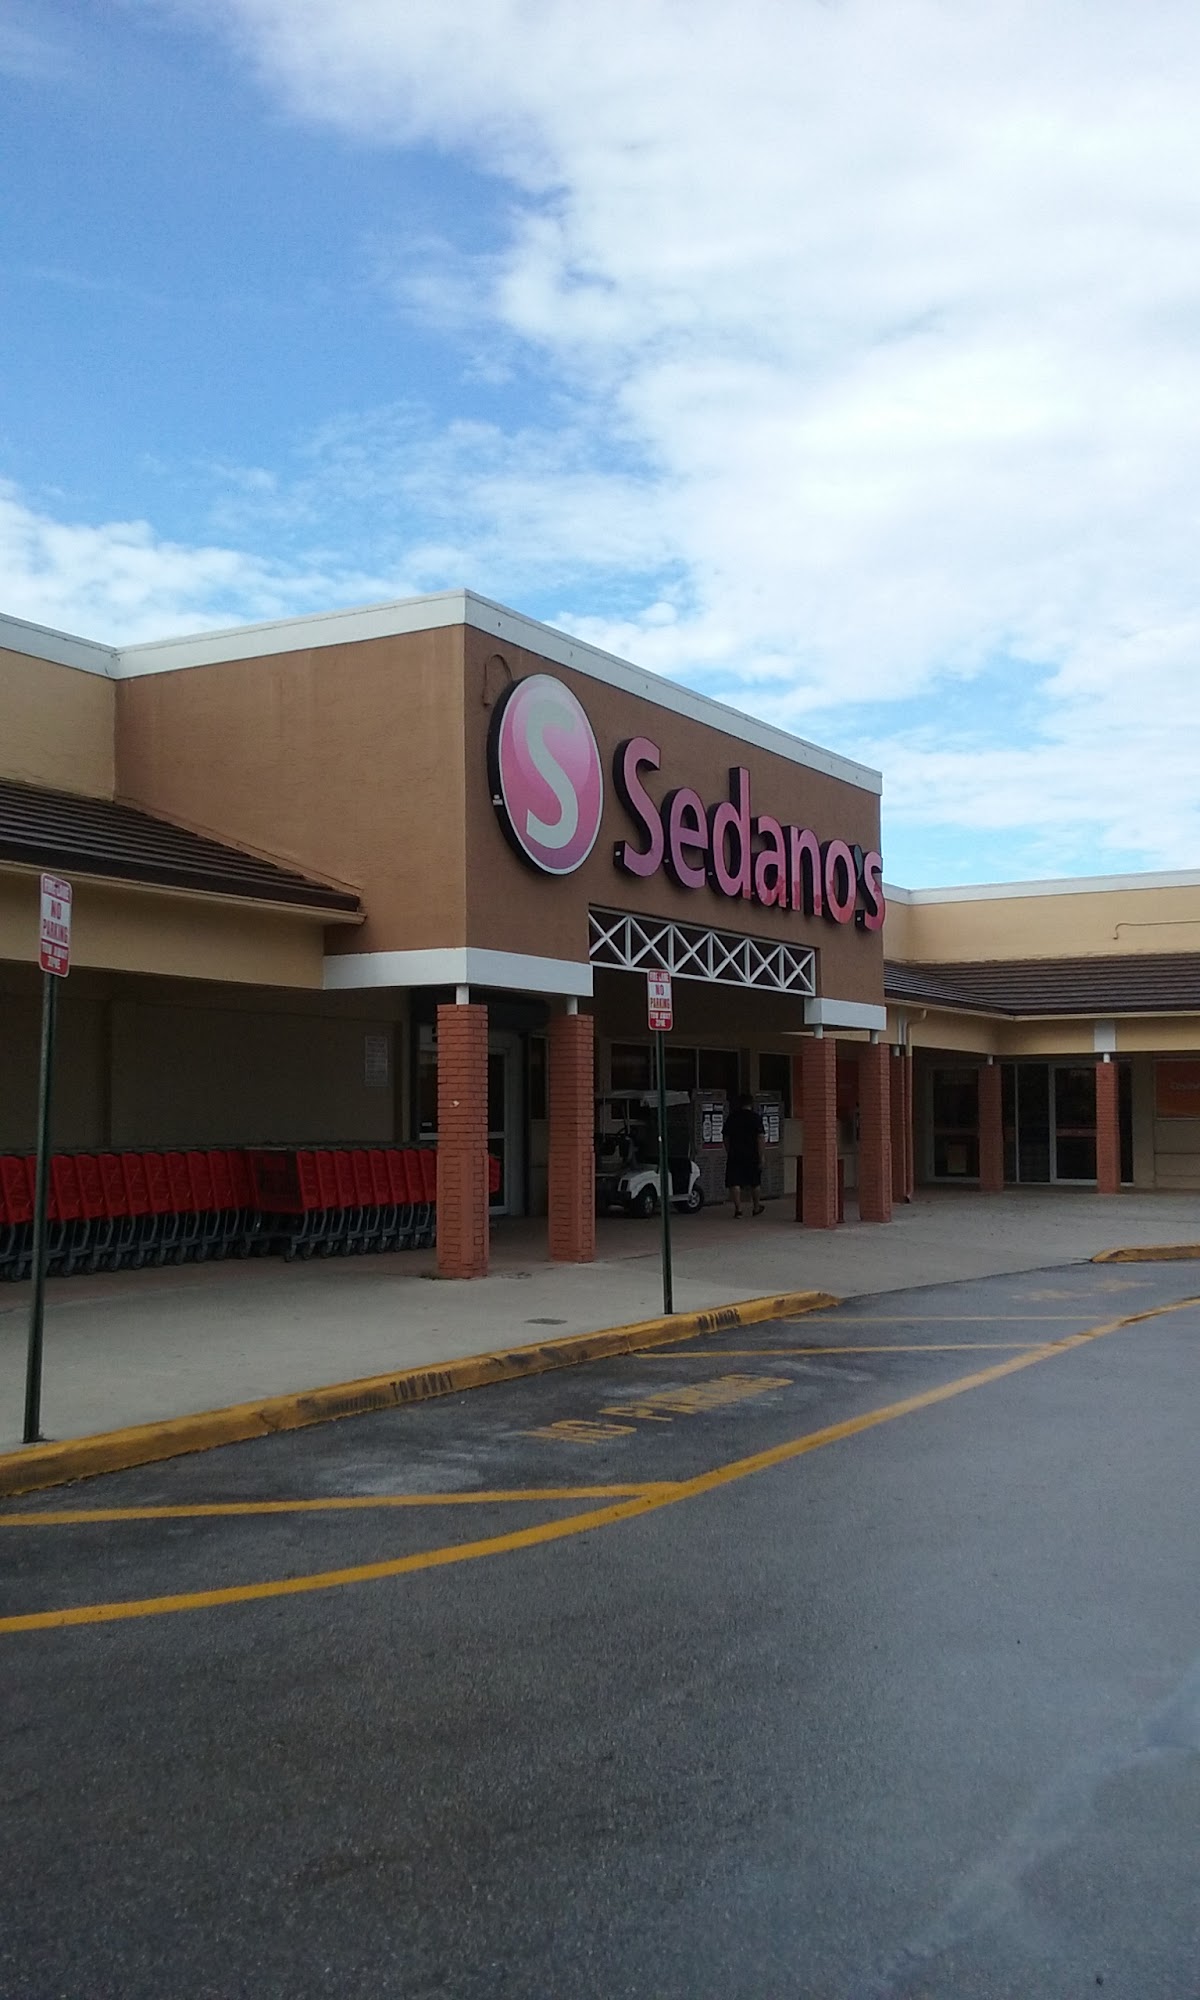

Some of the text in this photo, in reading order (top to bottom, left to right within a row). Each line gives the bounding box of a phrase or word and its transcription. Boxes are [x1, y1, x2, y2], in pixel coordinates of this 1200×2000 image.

[525, 700, 579, 850] S
[613, 736, 886, 932] Sedano's
[51, 899, 62, 920] NO
[43, 918, 69, 943] PARKING
[655, 984, 665, 996] NO
[650, 997, 670, 1009] PARKING
[389, 1371, 453, 1400] TOW AWAY
